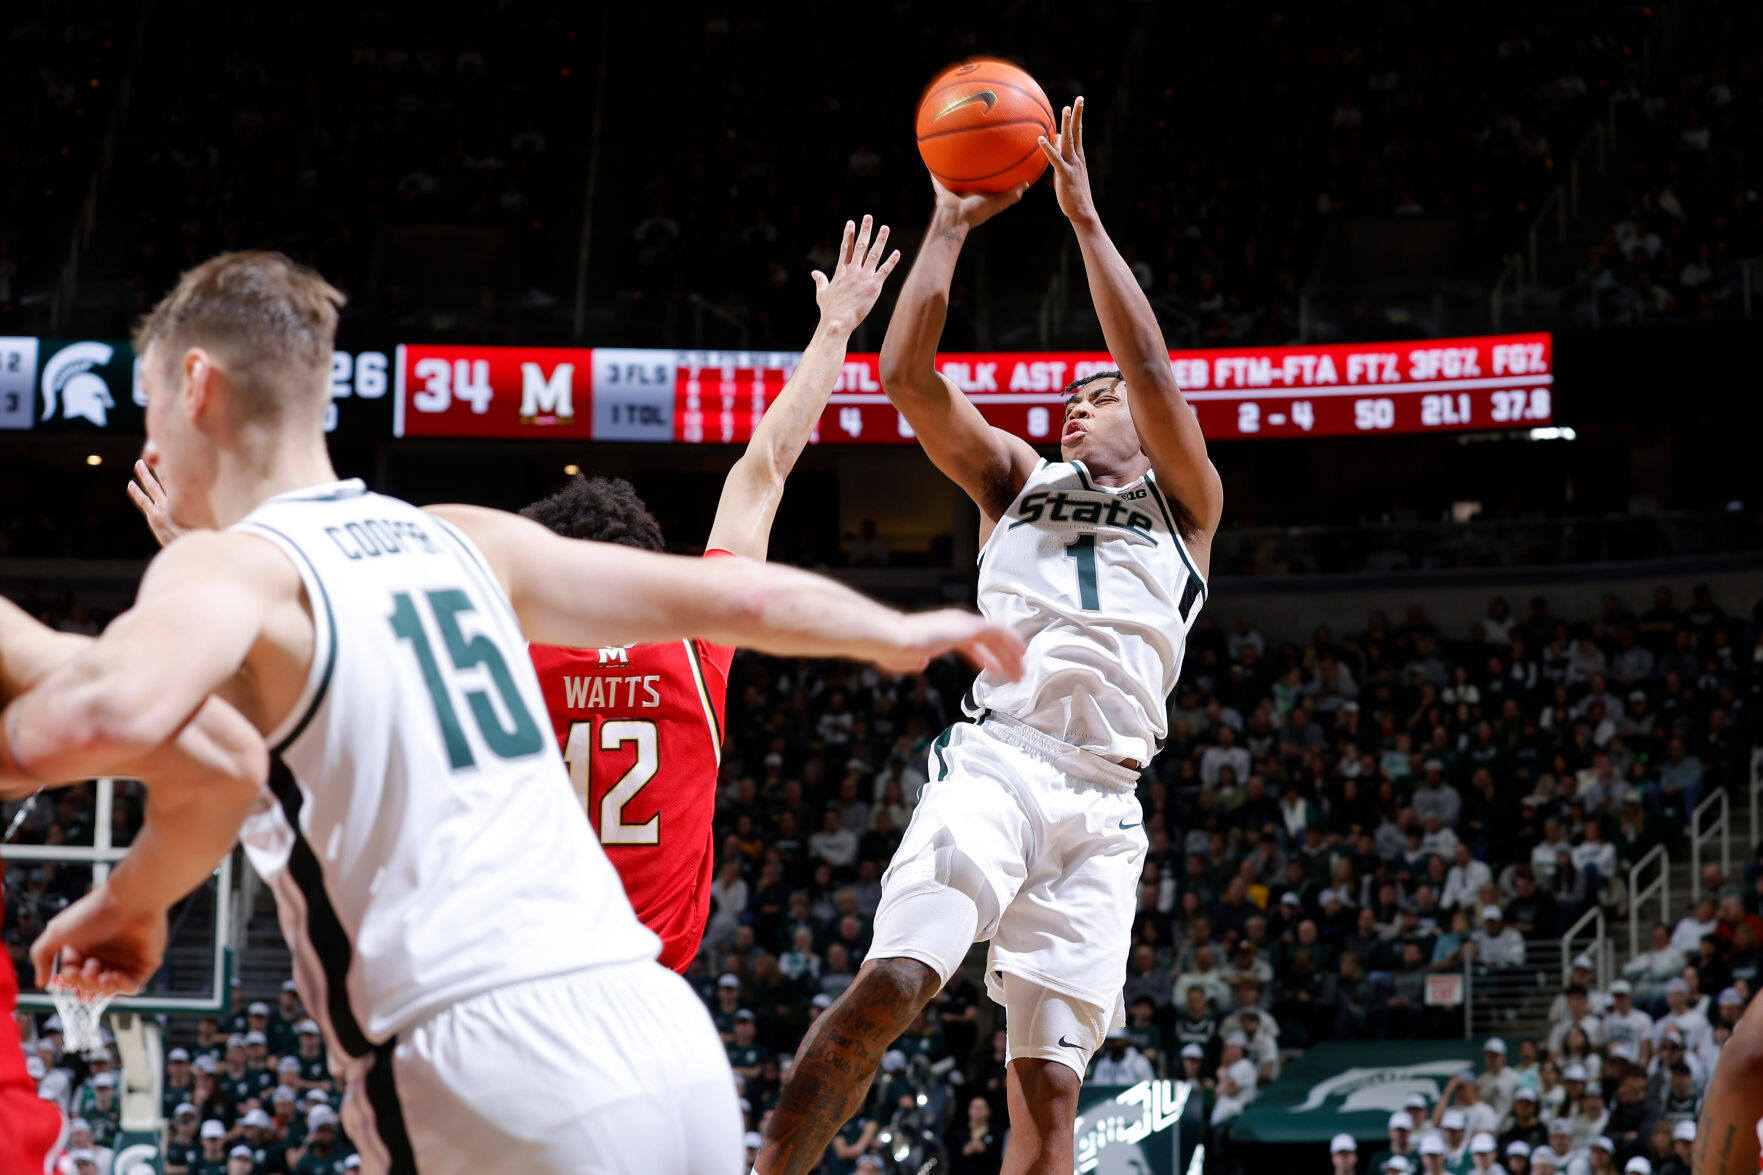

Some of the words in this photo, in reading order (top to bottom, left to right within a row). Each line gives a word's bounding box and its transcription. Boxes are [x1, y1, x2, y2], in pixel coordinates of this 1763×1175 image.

[331, 350, 389, 399] 26
[626, 364, 668, 385] FLS
[1172, 358, 1210, 389] EB
[1213, 353, 1338, 388] FTM-FTA
[1346, 352, 1401, 384] FT%
[1408, 346, 1482, 380] 3FG%
[1491, 342, 1548, 375] FG%
[413, 358, 494, 415] 34
[520, 362, 575, 421] M
[1009, 362, 1067, 392] AST
[839, 406, 863, 438] 4
[1017, 490, 1154, 532] State
[1064, 532, 1102, 613] 1
[596, 646, 631, 668] M
[386, 587, 546, 771] 15
[562, 674, 661, 709] WATTS
[562, 717, 661, 847] 12
